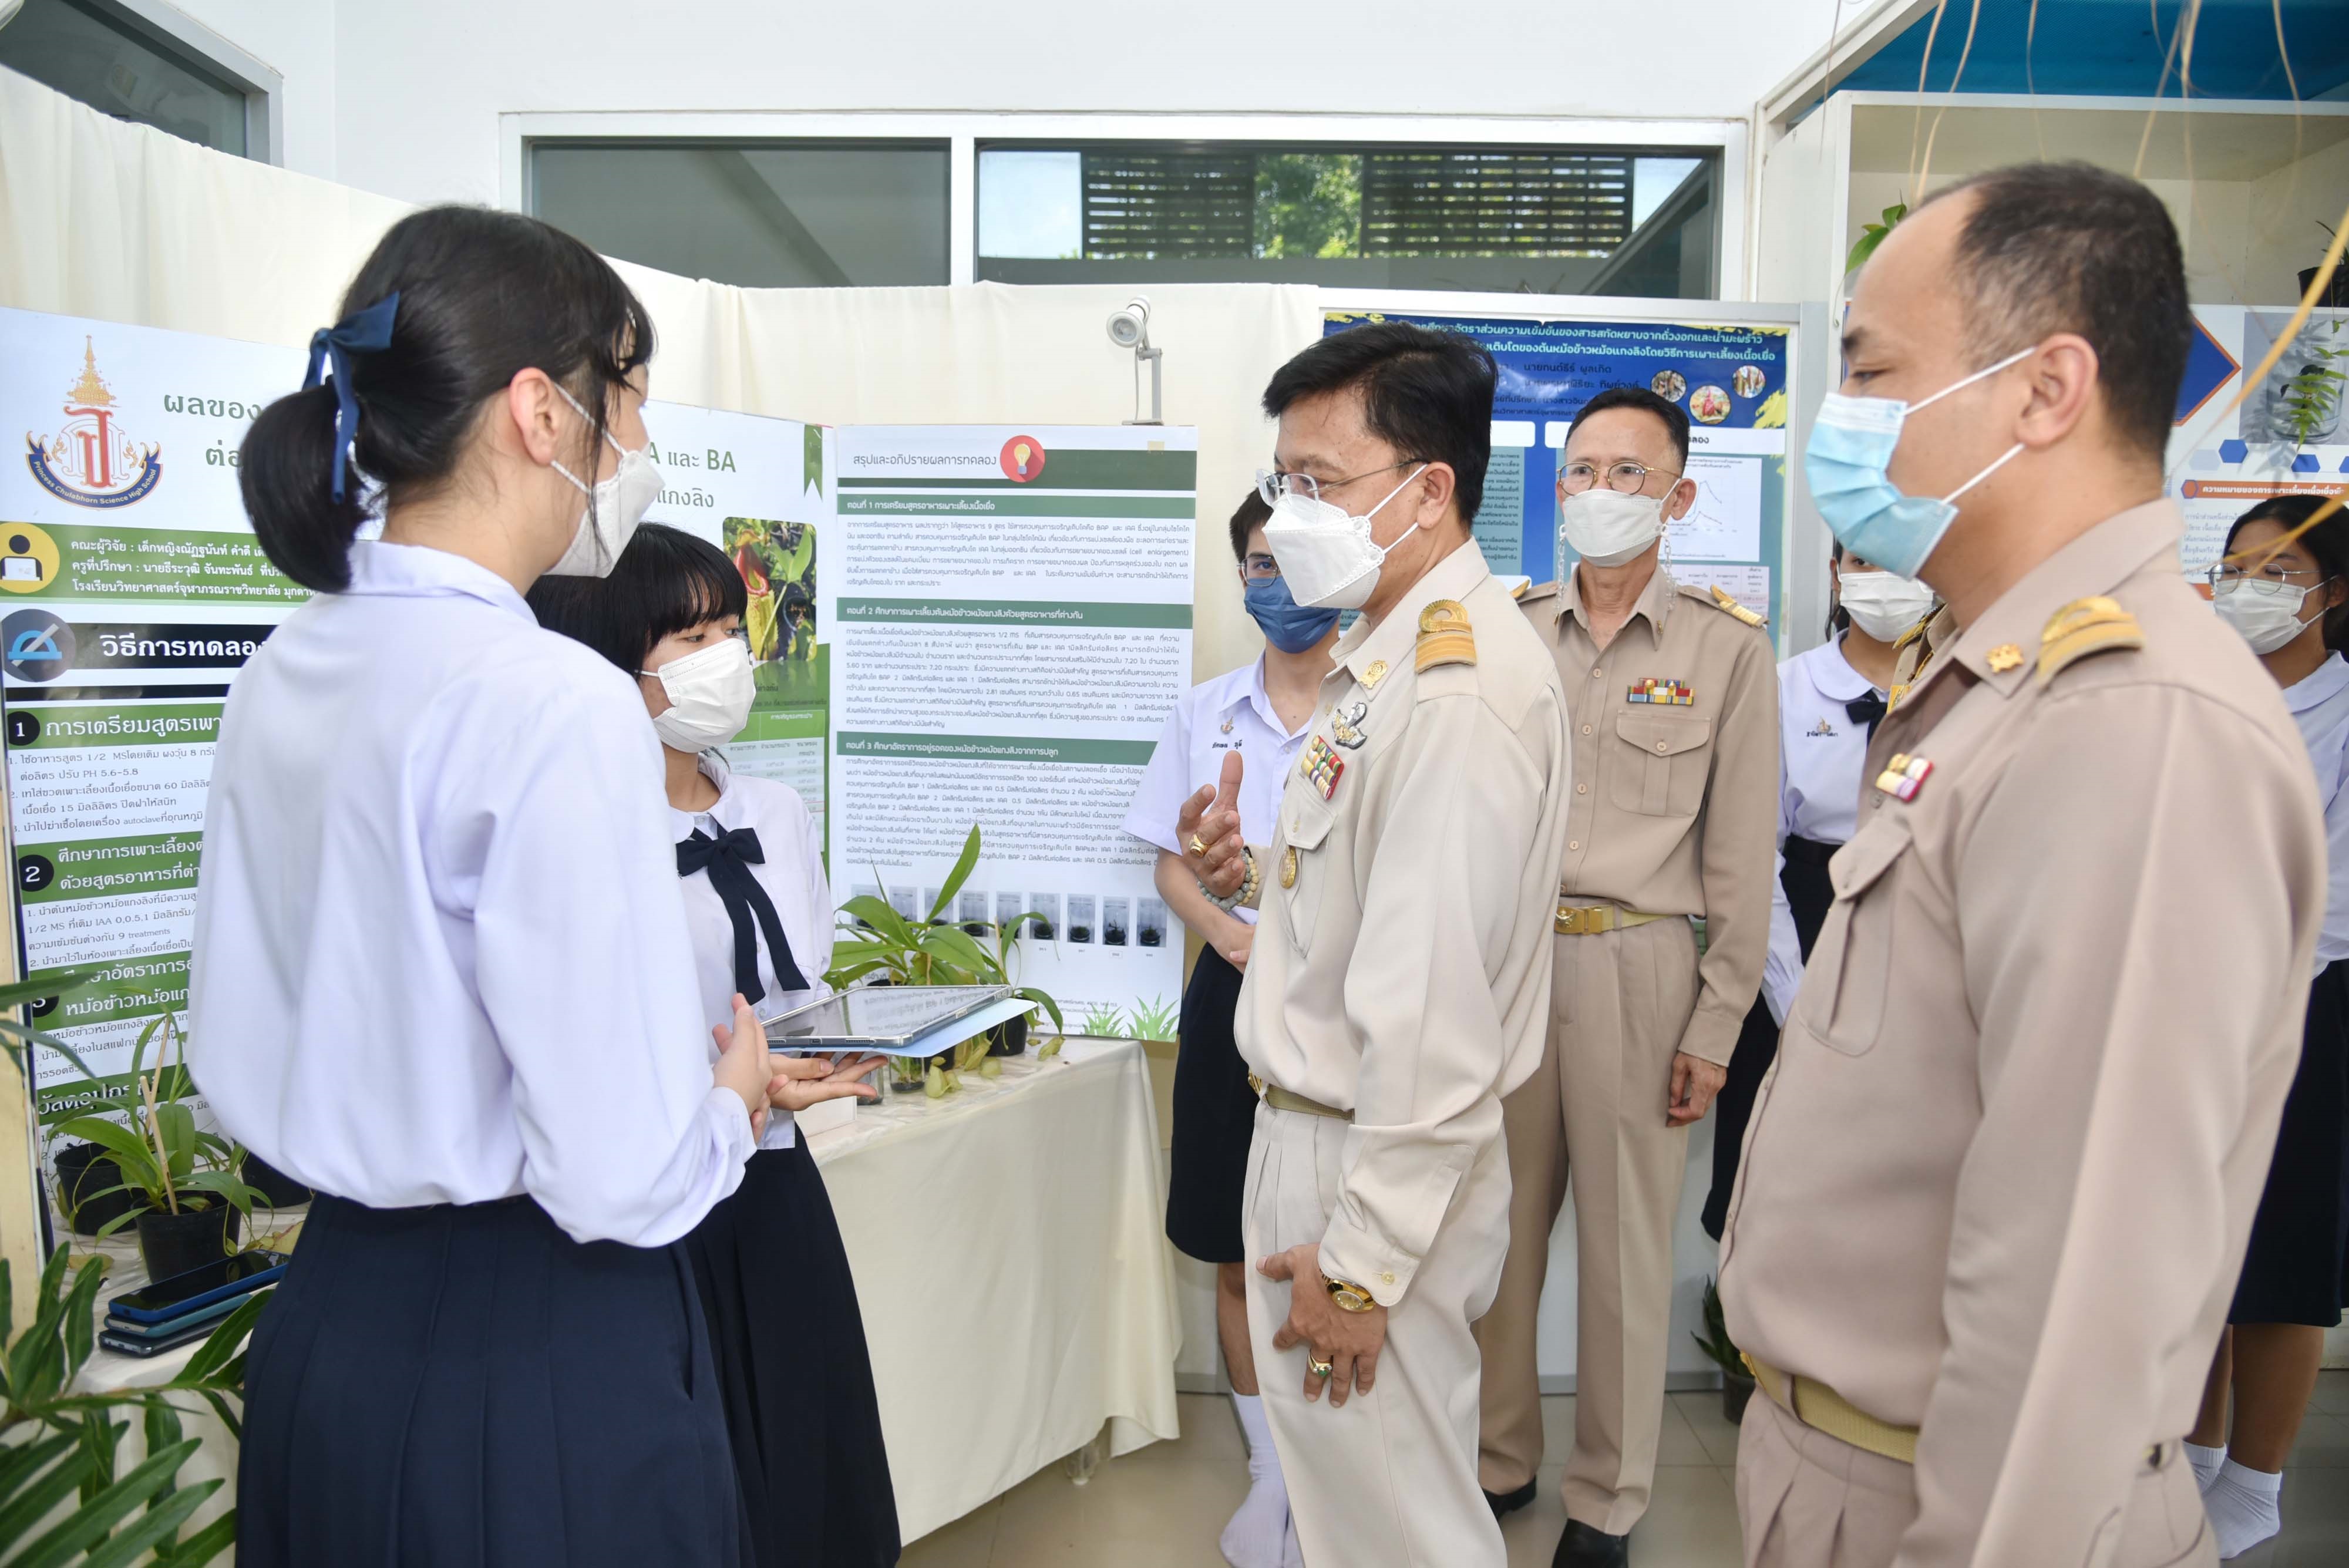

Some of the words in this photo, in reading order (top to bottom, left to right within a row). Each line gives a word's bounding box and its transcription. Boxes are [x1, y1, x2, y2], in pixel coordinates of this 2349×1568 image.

[164, 395, 263, 421] ผลของ
[668, 452, 700, 467] และ
[707, 449, 736, 473] BA
[33, 460, 55, 487] Princess
[55, 486, 98, 504] Chulabhorn
[100, 496, 129, 504] Science
[128, 488, 143, 499] High
[142, 469, 157, 489] School
[71, 538, 127, 554] คณะผู้วิจัย
[1147, 548, 1189, 557] enlargement)
[73, 556, 132, 574] ครูที่ปรึกษา
[16, 722, 25, 737] 1
[59, 769, 80, 779] ปรับ
[101, 768, 139, 777] 5.6-5.8
[26, 866, 41, 883] 2
[29, 925, 47, 934] 1/2
[51, 922, 66, 931] MS
[96, 917, 113, 926] IAA
[129, 928, 171, 939] treatments
